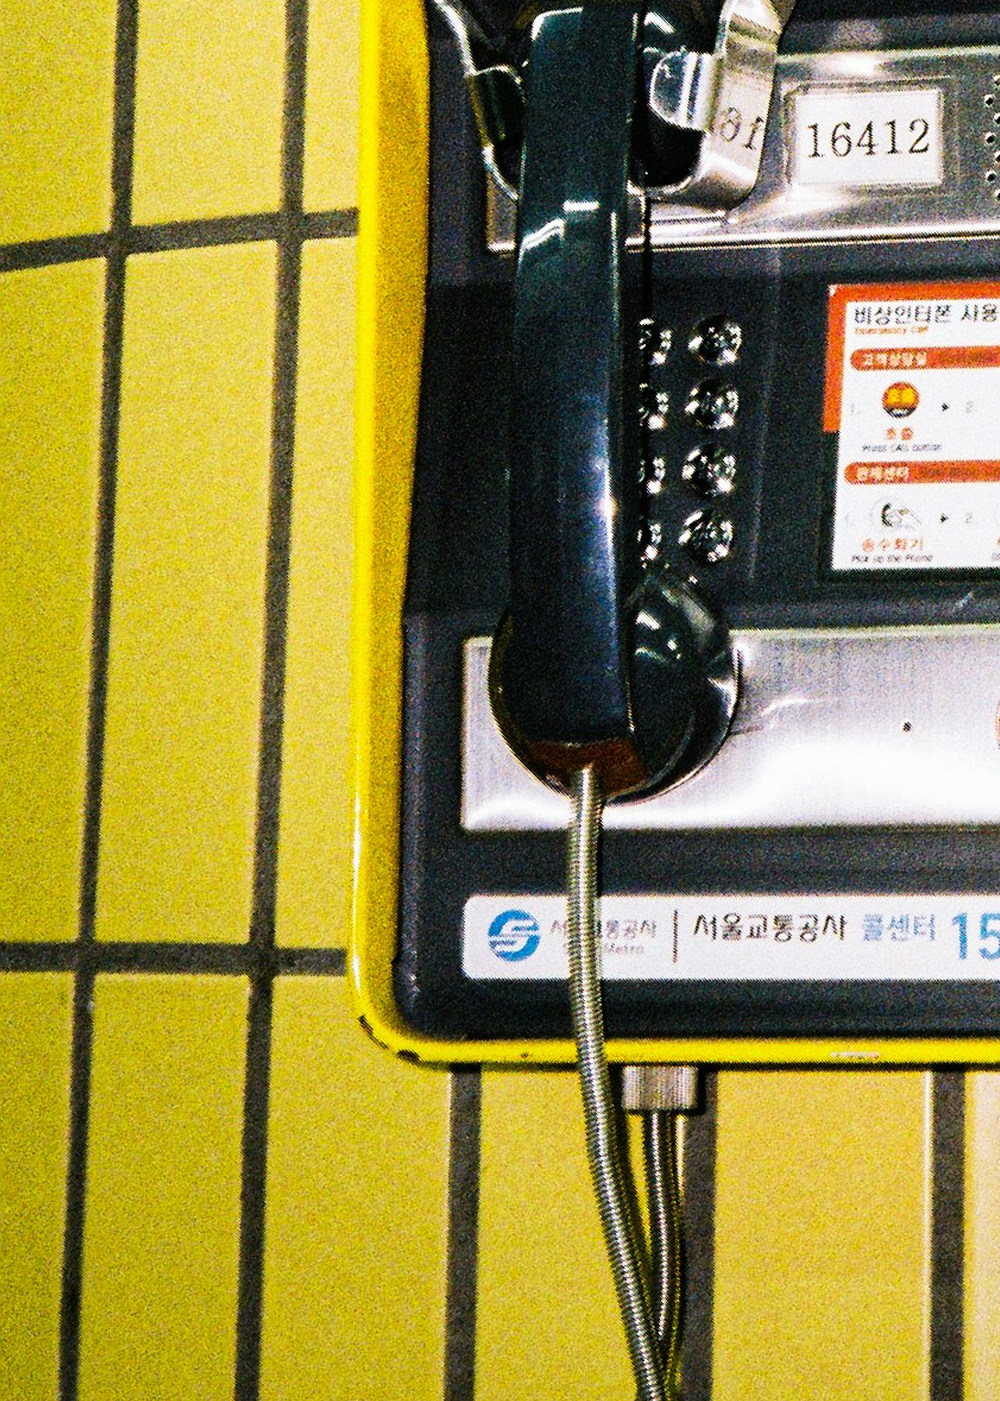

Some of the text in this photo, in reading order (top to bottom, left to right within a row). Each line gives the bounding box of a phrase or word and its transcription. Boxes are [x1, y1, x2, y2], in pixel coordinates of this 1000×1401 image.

[807, 117, 930, 159] 16412
[854, 303, 952, 325] 비상인터폰
[691, 910, 849, 944] 서울교통공사
[862, 912, 936, 942] 콜센터
